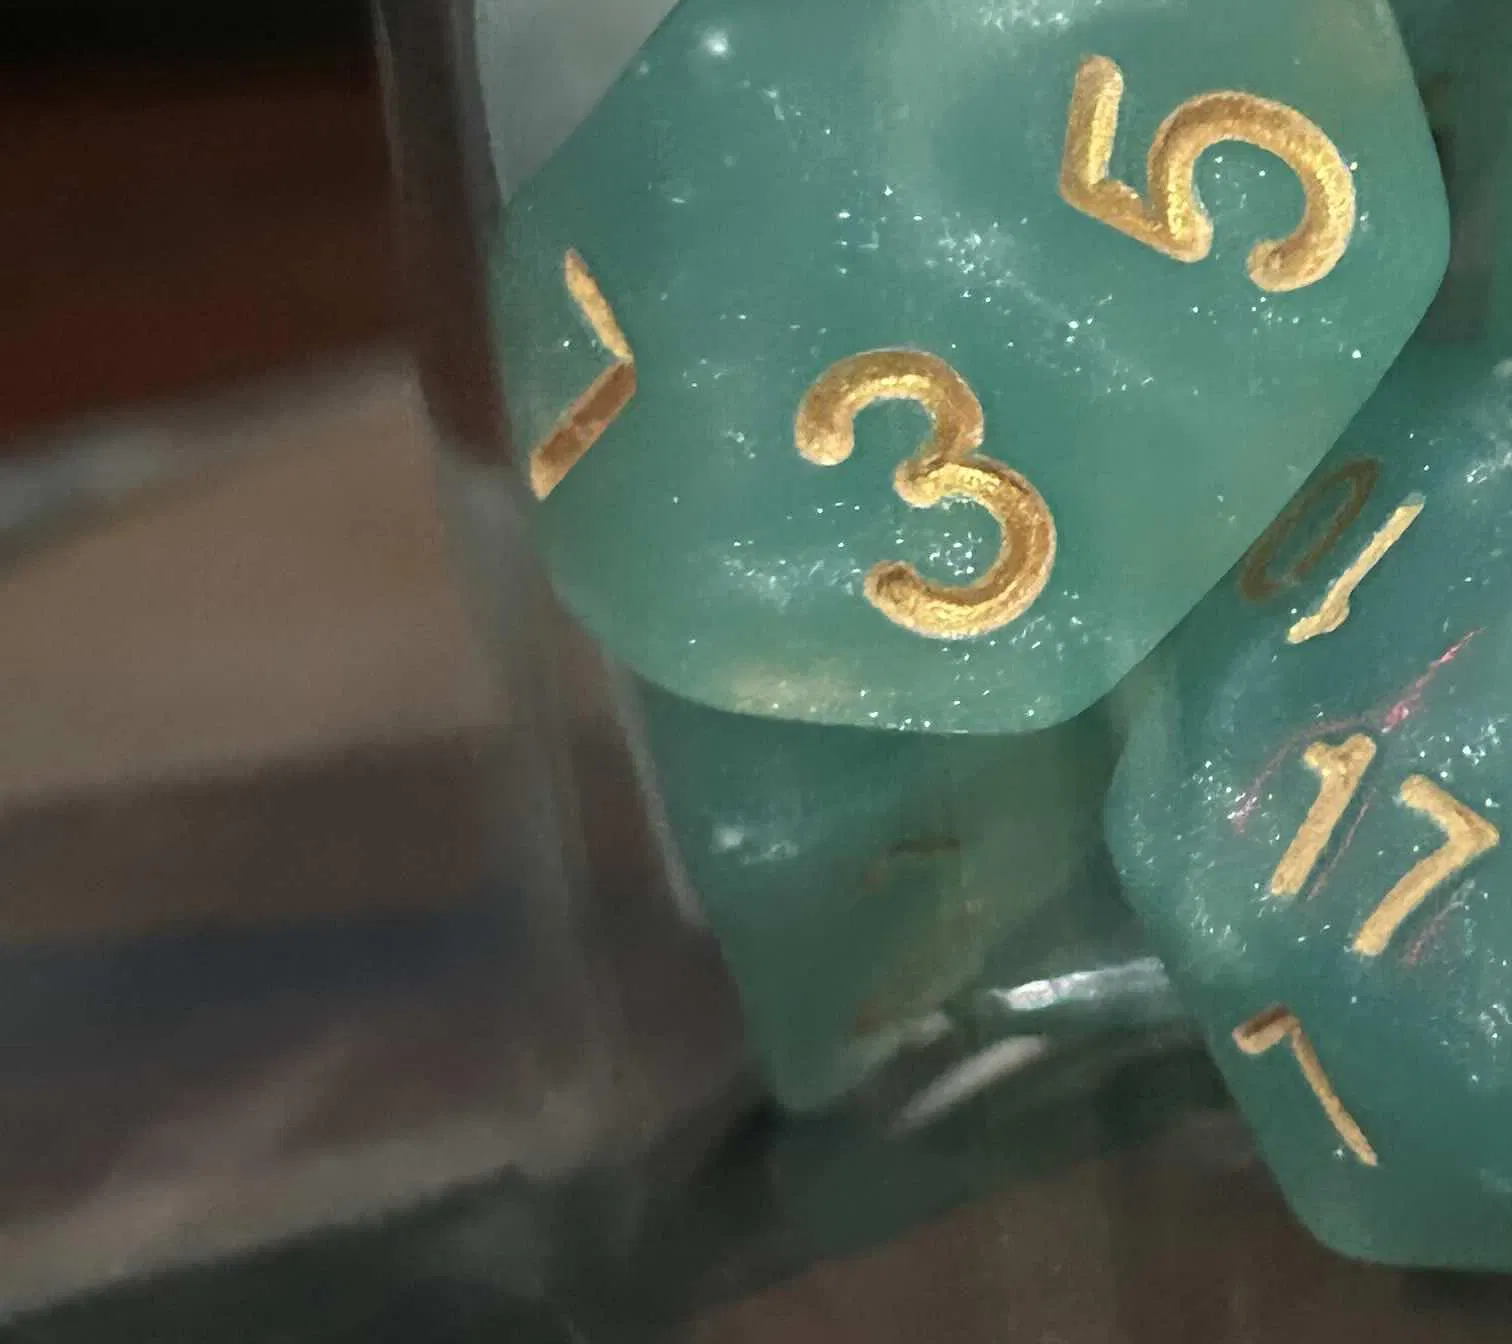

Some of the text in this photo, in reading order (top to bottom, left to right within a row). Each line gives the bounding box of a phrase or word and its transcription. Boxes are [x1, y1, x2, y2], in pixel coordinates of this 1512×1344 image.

[1059, 54, 1357, 293] 5
[795, 347, 1057, 640] 3
[1269, 732, 1501, 957] 17
